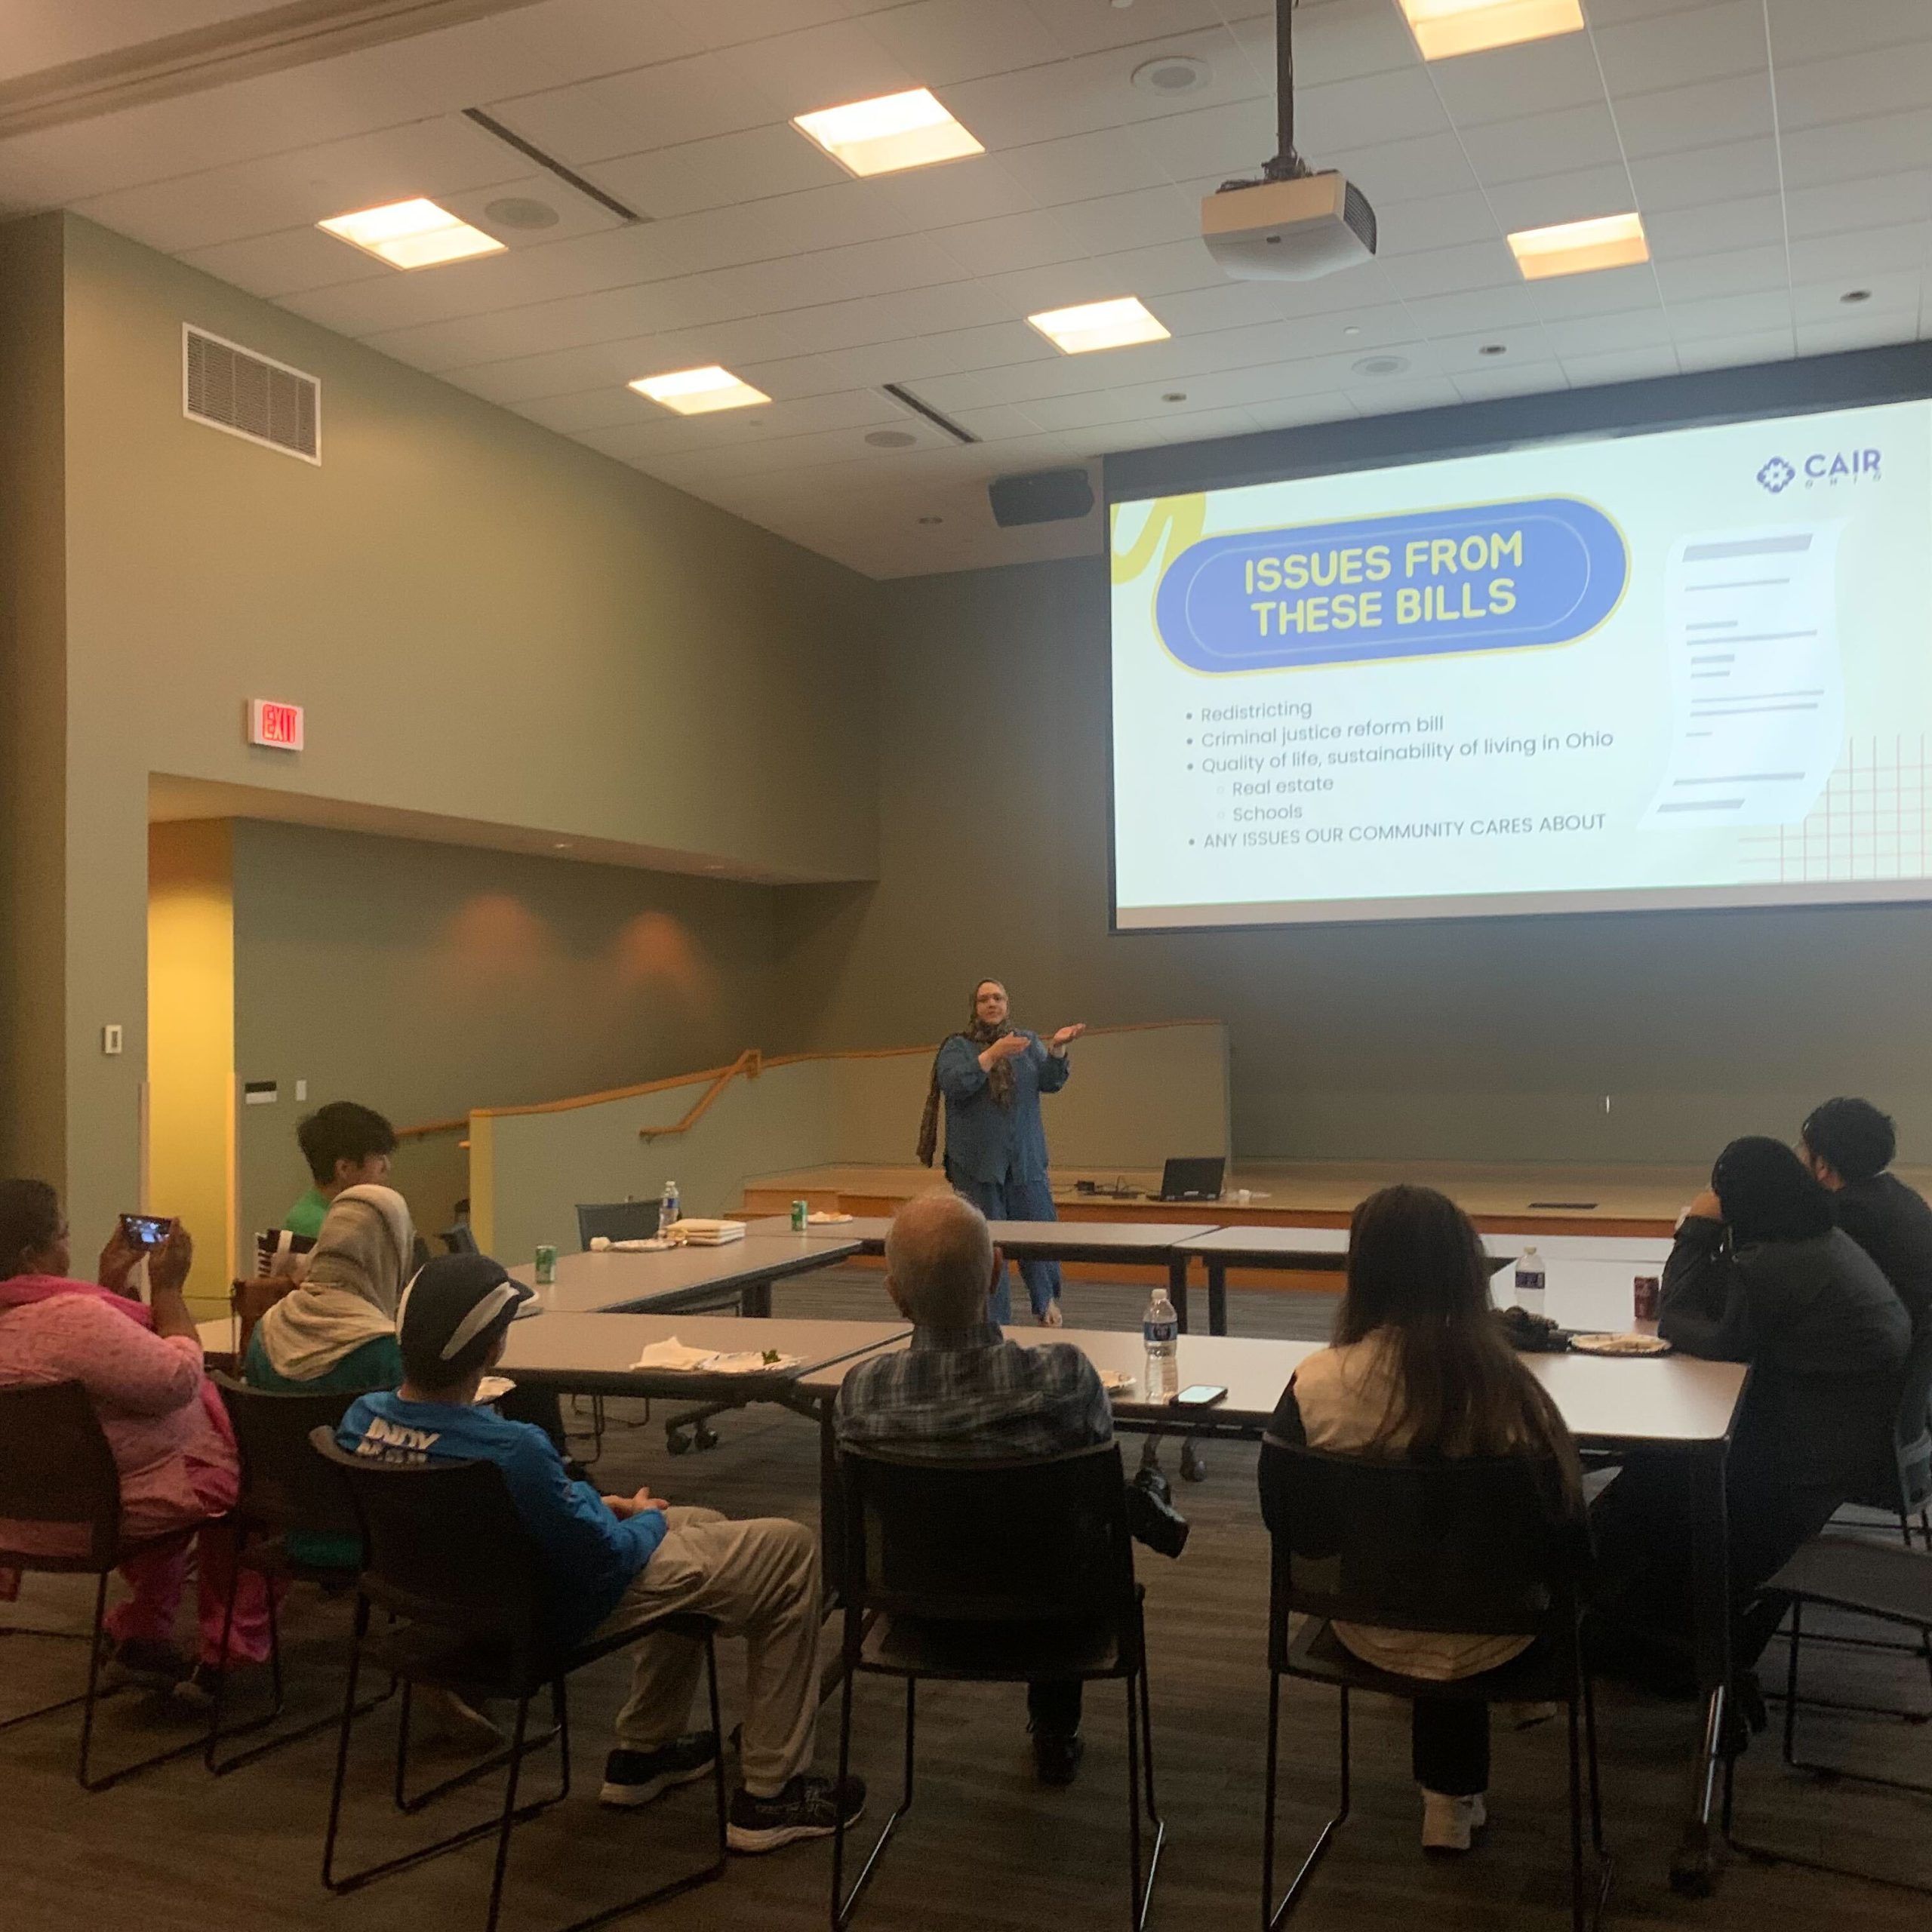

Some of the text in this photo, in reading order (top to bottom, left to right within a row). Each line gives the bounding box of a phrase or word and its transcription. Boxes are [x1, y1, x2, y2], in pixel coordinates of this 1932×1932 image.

[1804, 449, 1881, 478] CAIR
[1244, 530, 1523, 595] ISSUES FROM
[1250, 578, 1516, 637] THESE BILLS
[263, 703, 297, 743] EXIT
[1201, 701, 1312, 722] Redistricting
[1201, 715, 1444, 748] Criminal justice reform bill
[1201, 731, 1614, 774] Quality of life, sustainability of living in Ohio
[1232, 777, 1334, 796] Real estate
[1232, 804, 1303, 822] Schools
[1204, 813, 1607, 849] ANY ISSUES OUR COMMUNITY CARES ABOUT
